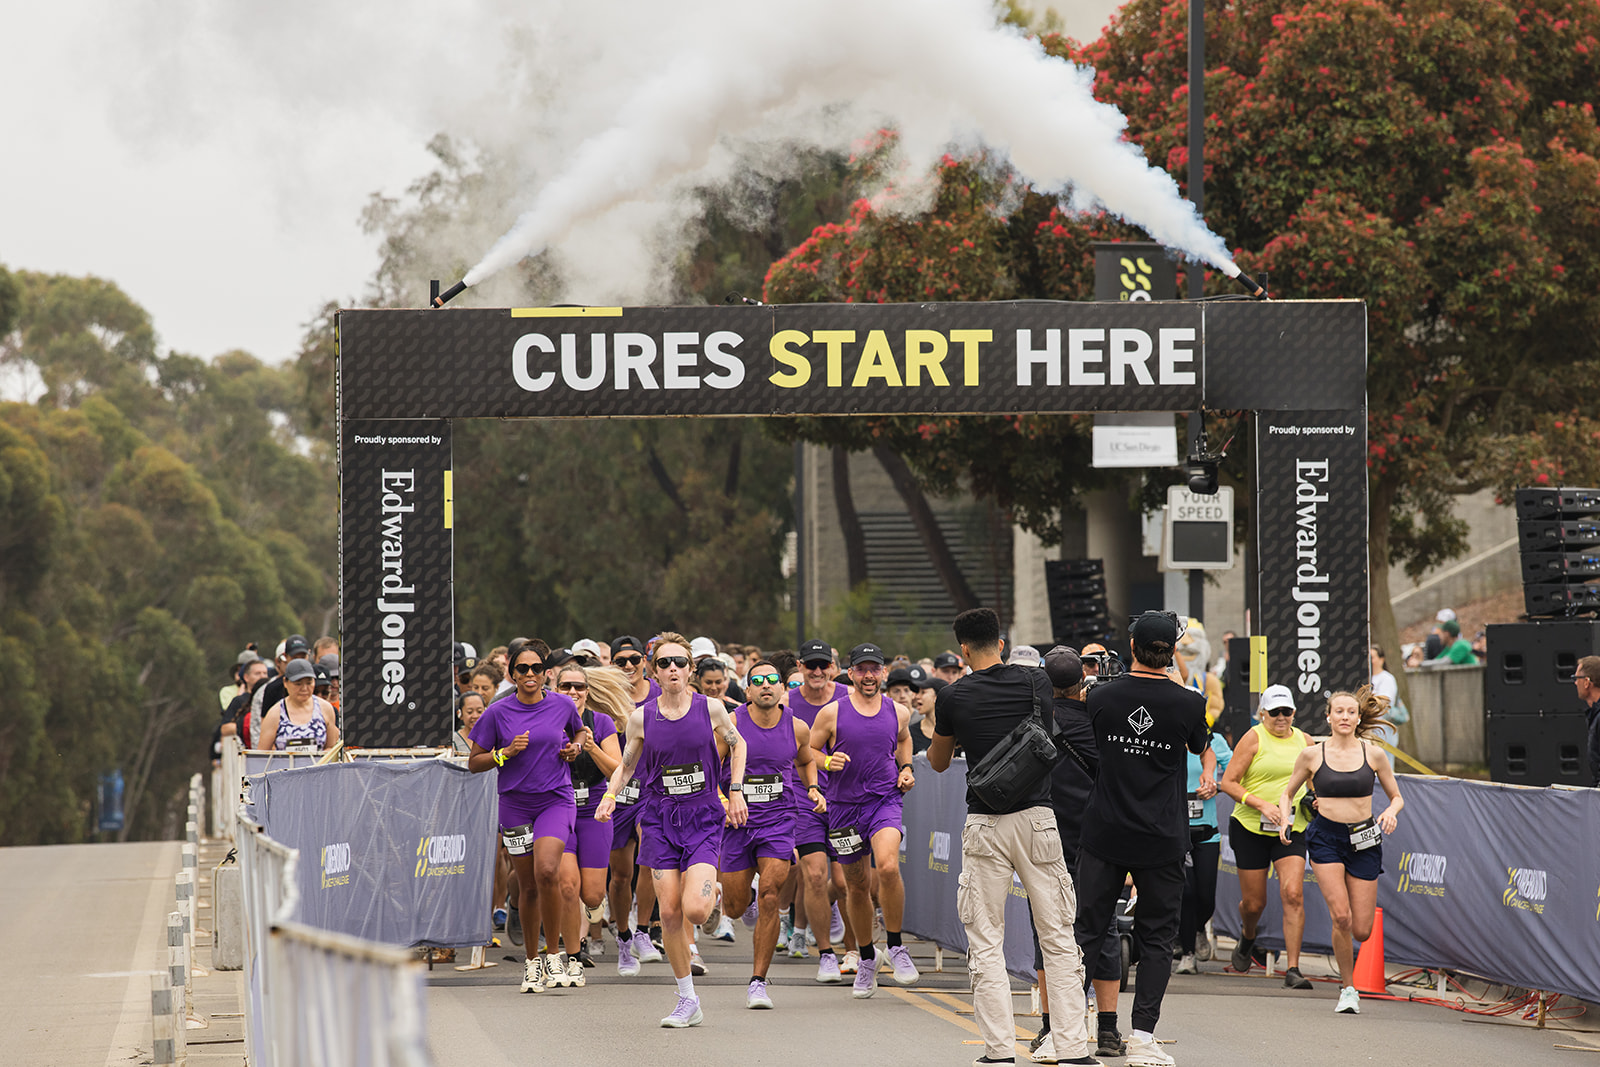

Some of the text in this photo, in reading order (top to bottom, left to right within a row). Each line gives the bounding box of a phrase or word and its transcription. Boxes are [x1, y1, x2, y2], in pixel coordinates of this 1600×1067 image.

[511, 327, 1196, 392] CURES START HERE
[1269, 425, 1356, 436] Proudly sponsored by
[354, 435, 442, 445] Proudly sponsored by
[1109, 441, 1123, 452] UC
[1138, 441, 1162, 453] Diego
[1181, 491, 1221, 504] YOUR
[1177, 506, 1223, 520] SPEED
[1107, 734, 1172, 750] SPEARHEAD
[1123, 747, 1150, 756] MEDIA
[673, 774, 694, 786] 1540
[754, 785, 773, 794] 1673
[1360, 828, 1376, 841] 1824
[508, 836, 526, 846] 1672
[837, 838, 852, 848] 1511
